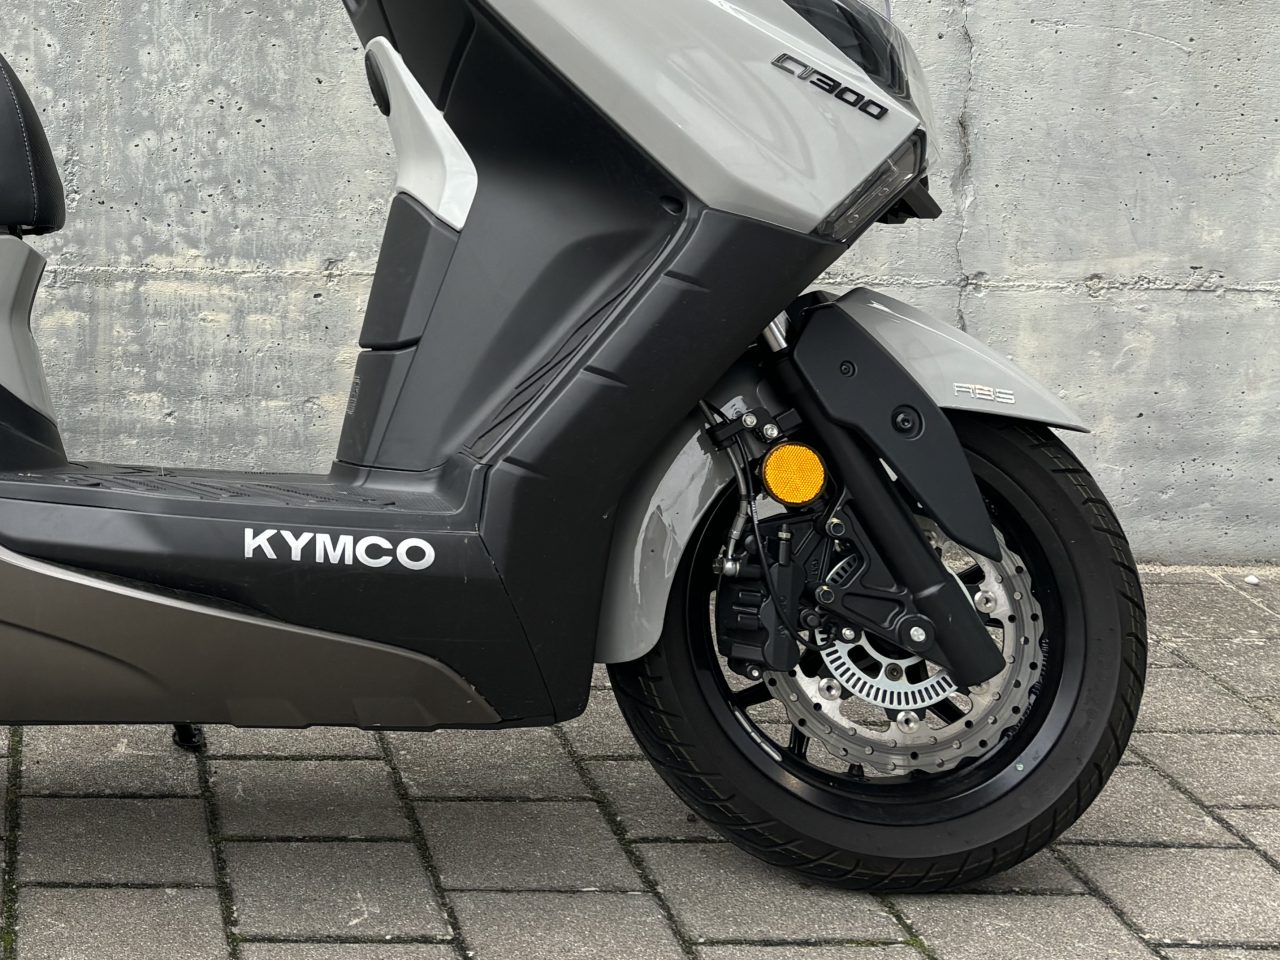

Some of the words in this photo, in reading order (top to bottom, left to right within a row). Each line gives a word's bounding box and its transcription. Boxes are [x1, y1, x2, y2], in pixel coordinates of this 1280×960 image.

[771, 52, 889, 121] CT300
[952, 382, 1017, 404] ABS
[244, 527, 436, 571] KYMCO
